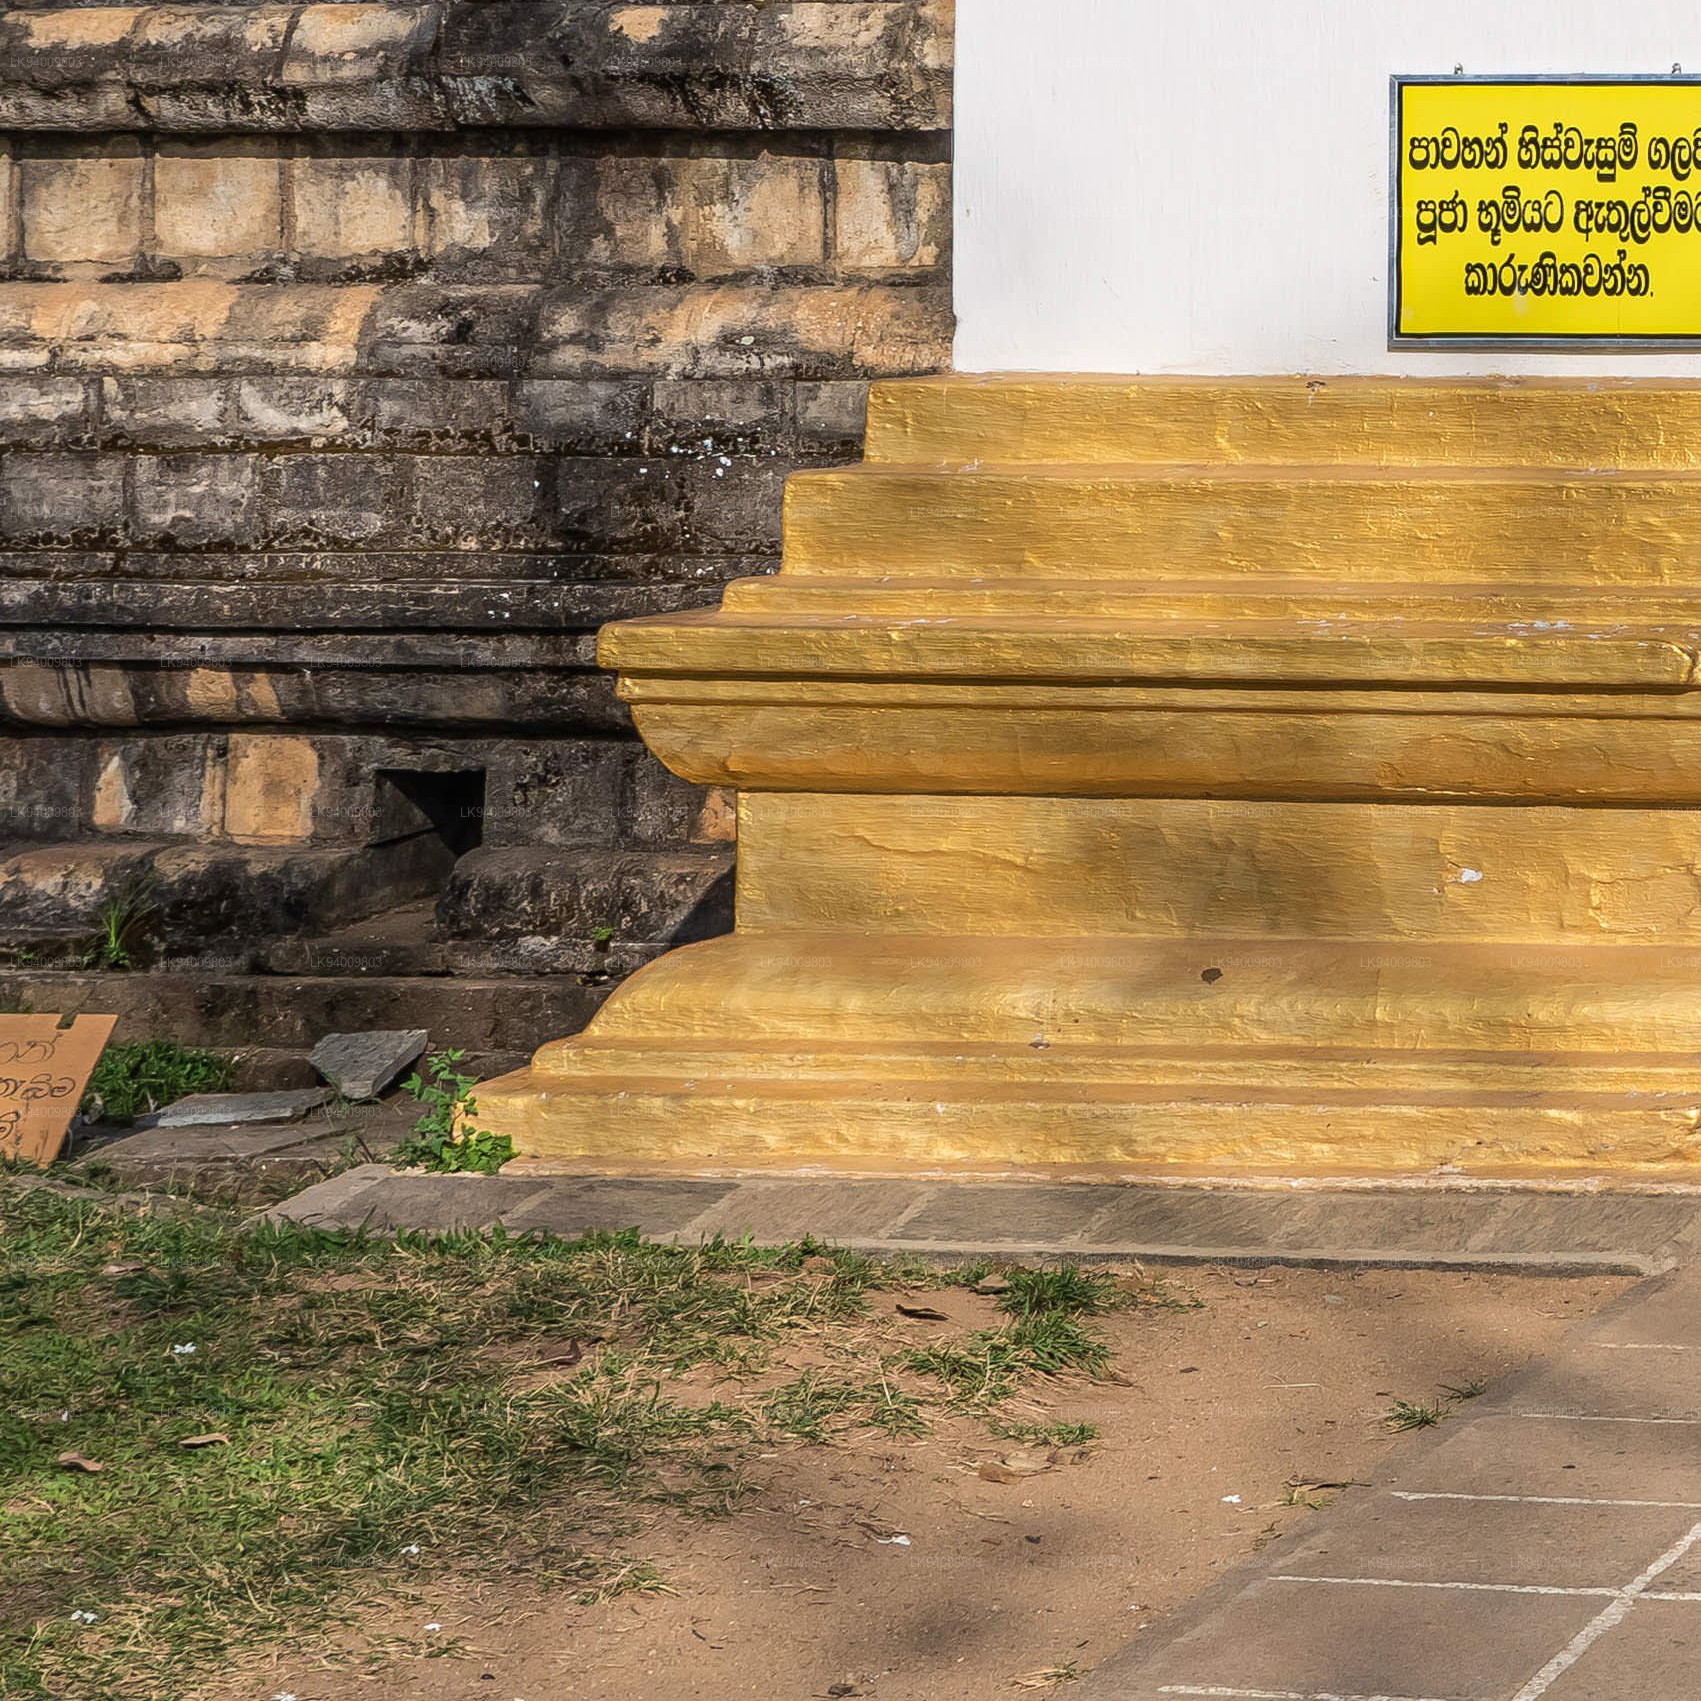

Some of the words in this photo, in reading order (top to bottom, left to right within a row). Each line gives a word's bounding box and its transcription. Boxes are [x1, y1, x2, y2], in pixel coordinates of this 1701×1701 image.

[1409, 122, 1507, 170] පාවහන්
[1518, 123, 1638, 182] හිස්වැසුම්
[1417, 190, 1467, 245] පූජා
[1477, 186, 1564, 246] භූමියට
[1465, 249, 1653, 296] කාරුණිකවන්න.
